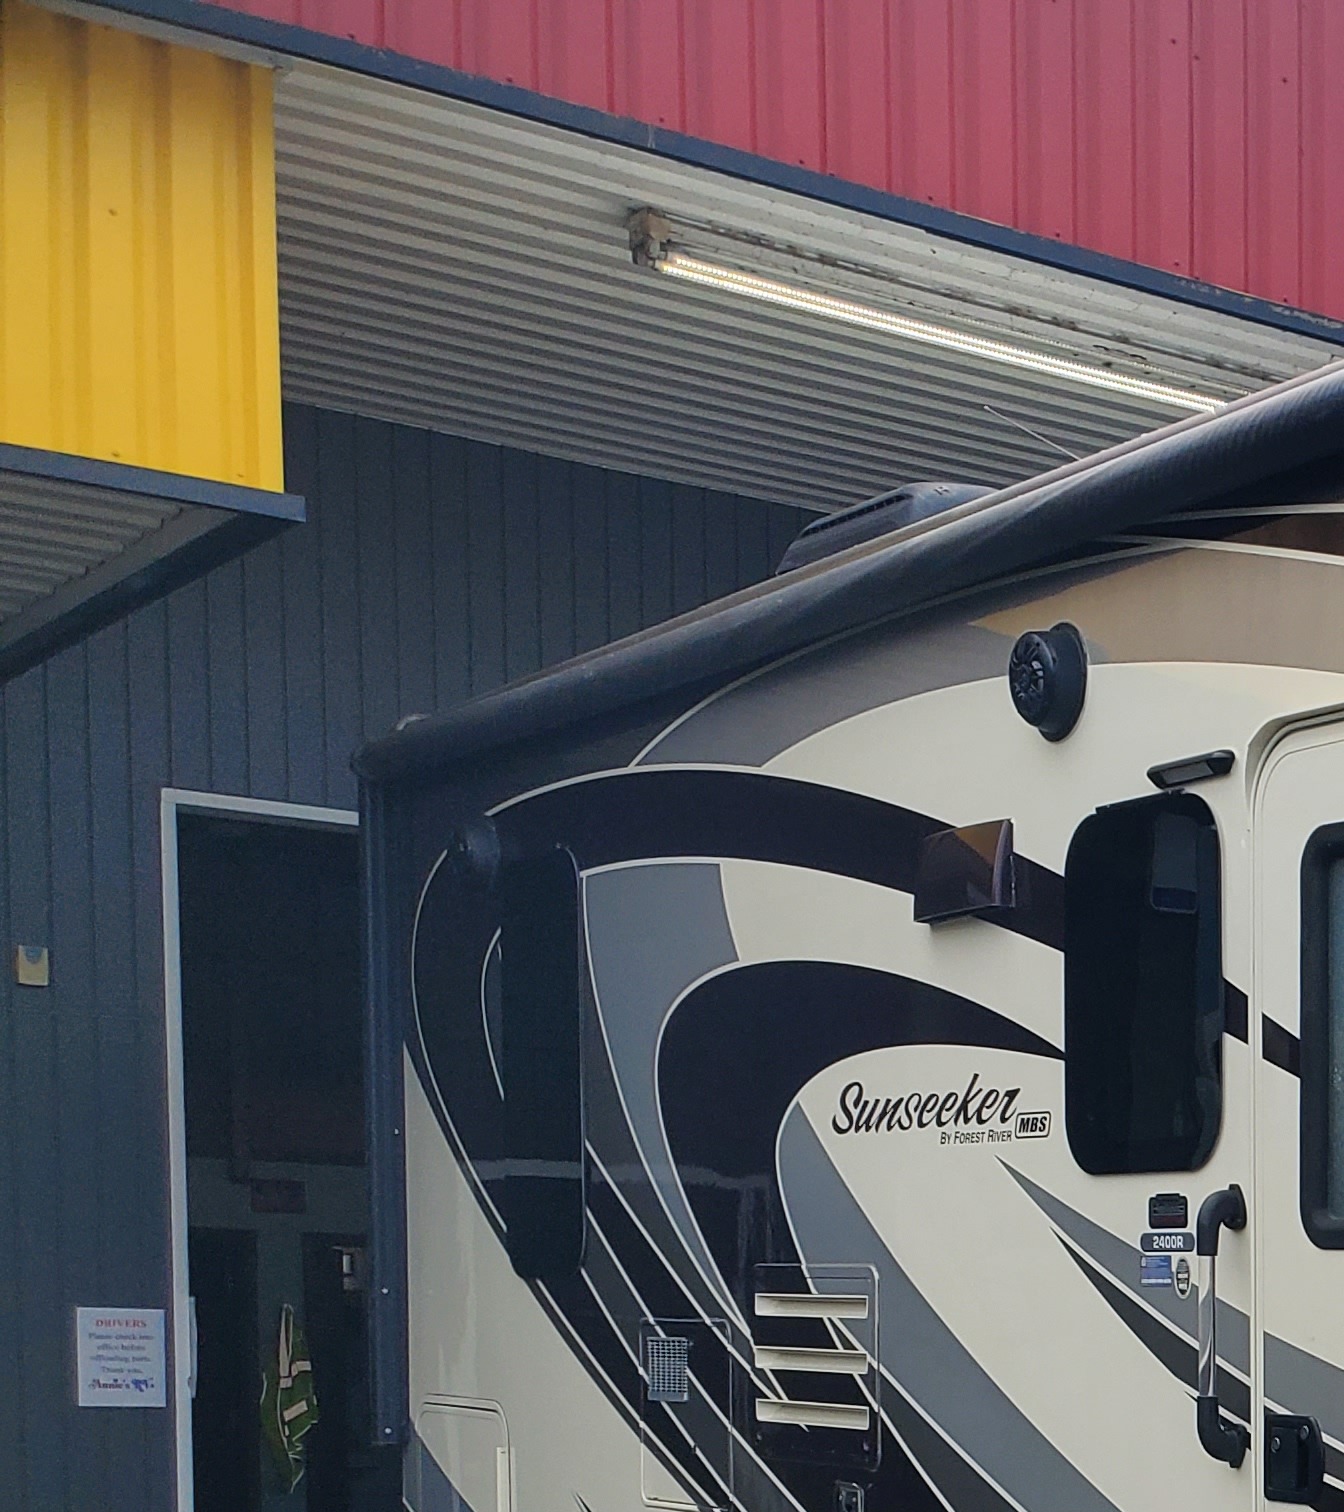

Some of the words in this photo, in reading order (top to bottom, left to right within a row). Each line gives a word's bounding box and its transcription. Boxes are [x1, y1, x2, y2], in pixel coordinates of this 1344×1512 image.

[831, 1073, 1021, 1135] Sunseeker
[940, 1132, 951, 1145] BY
[953, 1130, 985, 1144] FOREST
[987, 1129, 1013, 1143] RIVER
[1018, 1116, 1048, 1134] MBS
[1152, 1235, 1184, 1249] 2400R
[95, 1319, 148, 1328] DRIVERS
